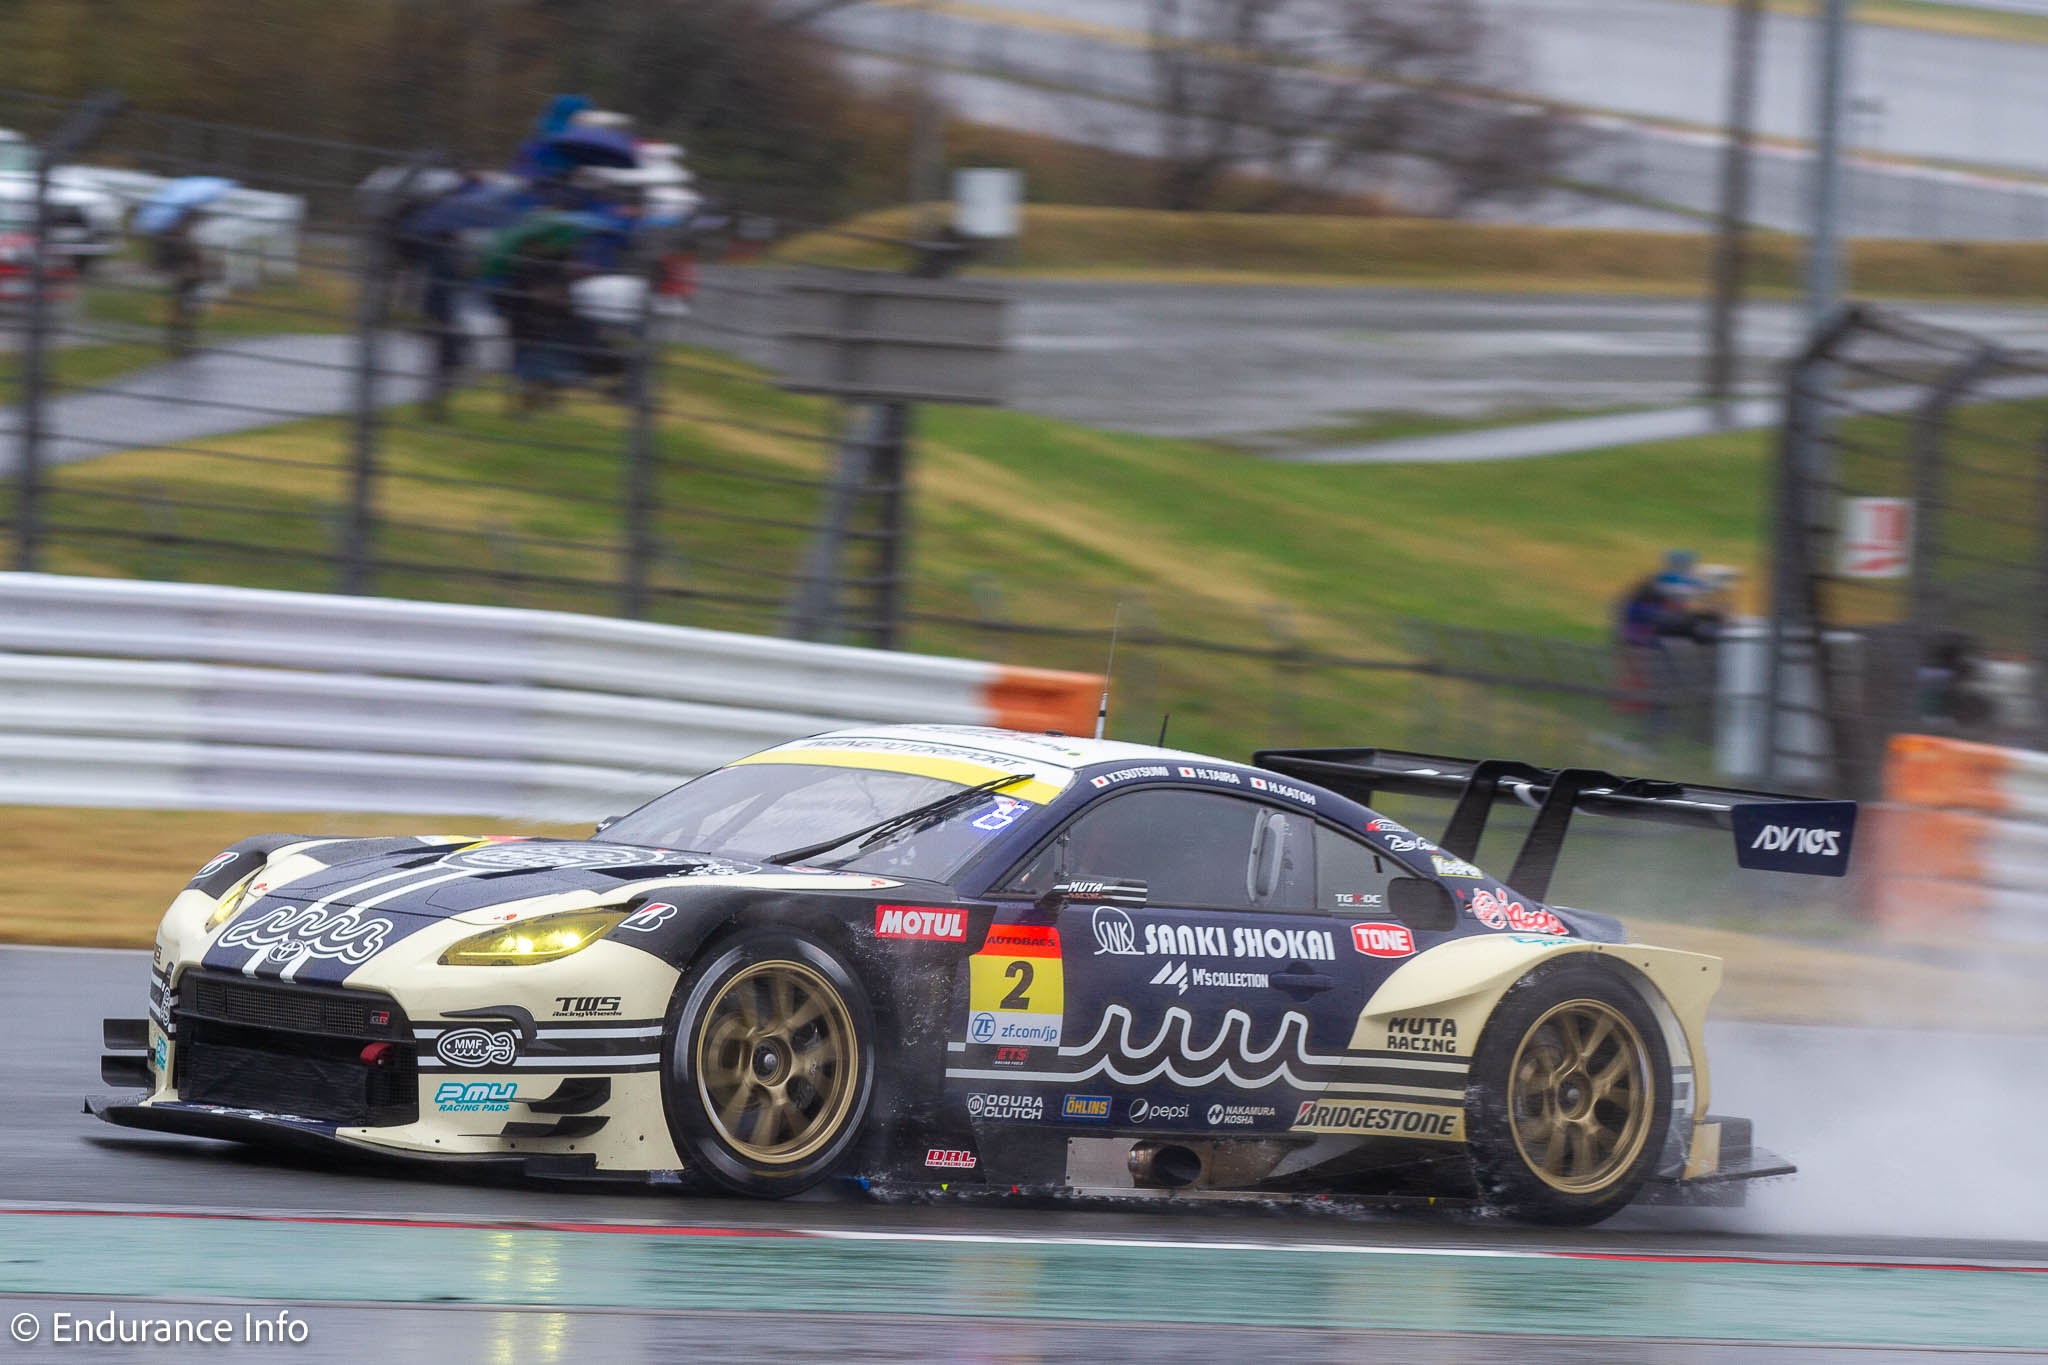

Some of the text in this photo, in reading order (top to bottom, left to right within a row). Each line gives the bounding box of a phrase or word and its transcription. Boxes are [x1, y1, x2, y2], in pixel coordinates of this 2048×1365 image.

[1106, 766, 1169, 783] Y.TSUTSUMI
[1196, 768, 1241, 784] H.TAIRA
[1268, 781, 1317, 805] H.KATOH
[1751, 825, 1841, 856] ADVICS
[1068, 881, 1104, 892] MUTA
[879, 910, 963, 937] MOTUL
[987, 936, 1056, 947] AUTOBACS
[1144, 923, 1336, 961] SANKI SHOKAI
[1356, 928, 1409, 951] TONE
[999, 960, 1034, 1010] 2
[555, 996, 622, 1011] TWS
[1001, 1024, 1058, 1042] zf.com/jp
[1388, 1018, 1456, 1037] MUTA
[454, 1039, 483, 1049] MMF
[1387, 1035, 1456, 1053] RACING
[997, 1047, 1028, 1061] ETS
[439, 1104, 510, 1112] RACING PADS
[987, 1095, 1043, 1107] OGURA
[1066, 1097, 1107, 1114] ÖHLINS
[984, 1107, 1043, 1119] CLUTCH
[1149, 1104, 1190, 1119] pepsi
[1226, 1106, 1275, 1115] NAKAMURA
[1295, 1101, 1457, 1135] BRIDGESTONE
[1224, 1115, 1254, 1124] KOSHA
